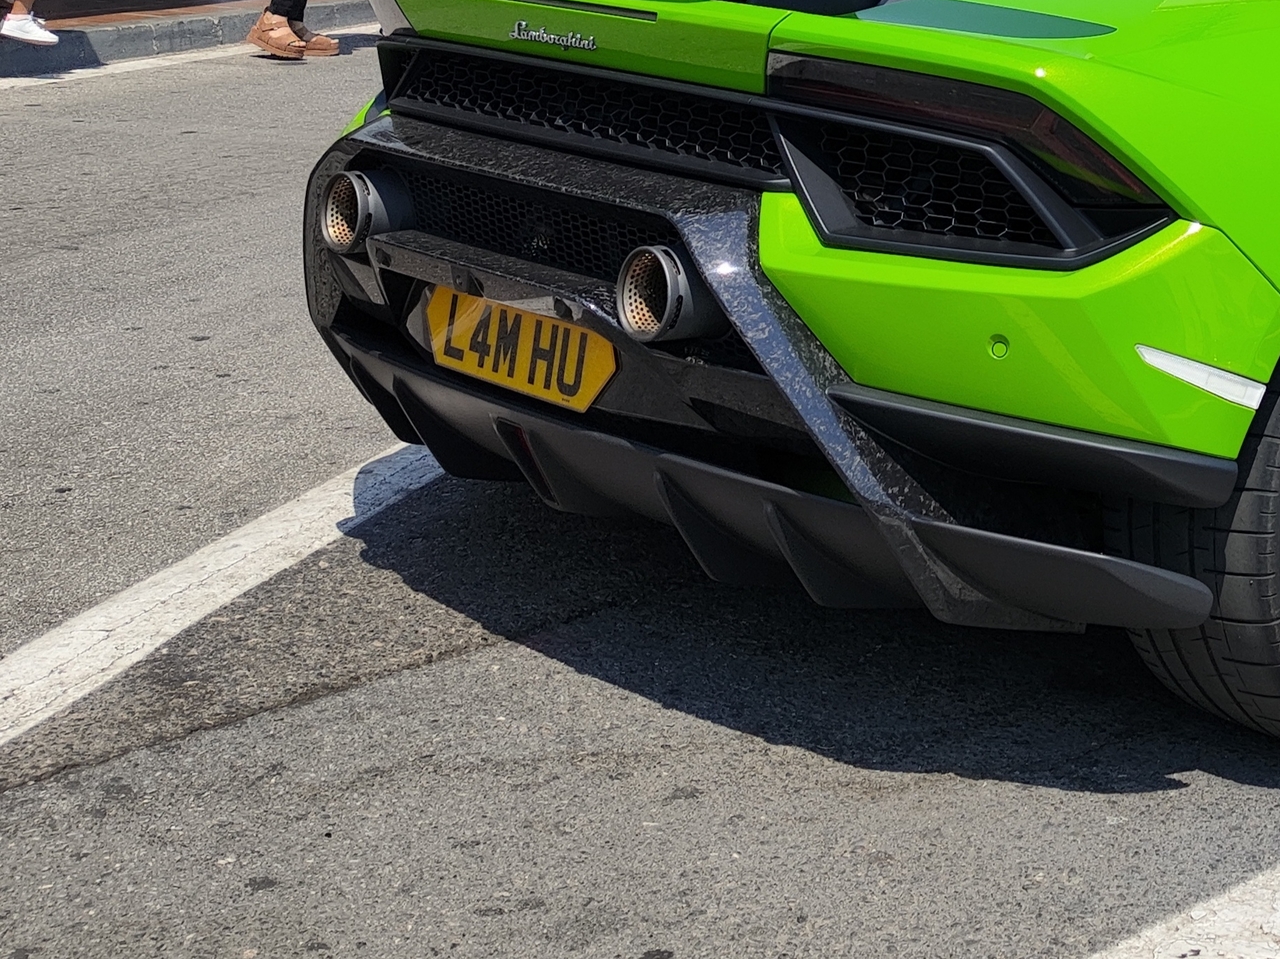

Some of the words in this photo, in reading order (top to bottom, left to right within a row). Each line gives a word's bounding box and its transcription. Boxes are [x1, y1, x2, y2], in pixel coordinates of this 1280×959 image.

[508, 19, 597, 51] Lamborghini
[443, 293, 523, 379] L4M
[527, 318, 589, 398] HU
